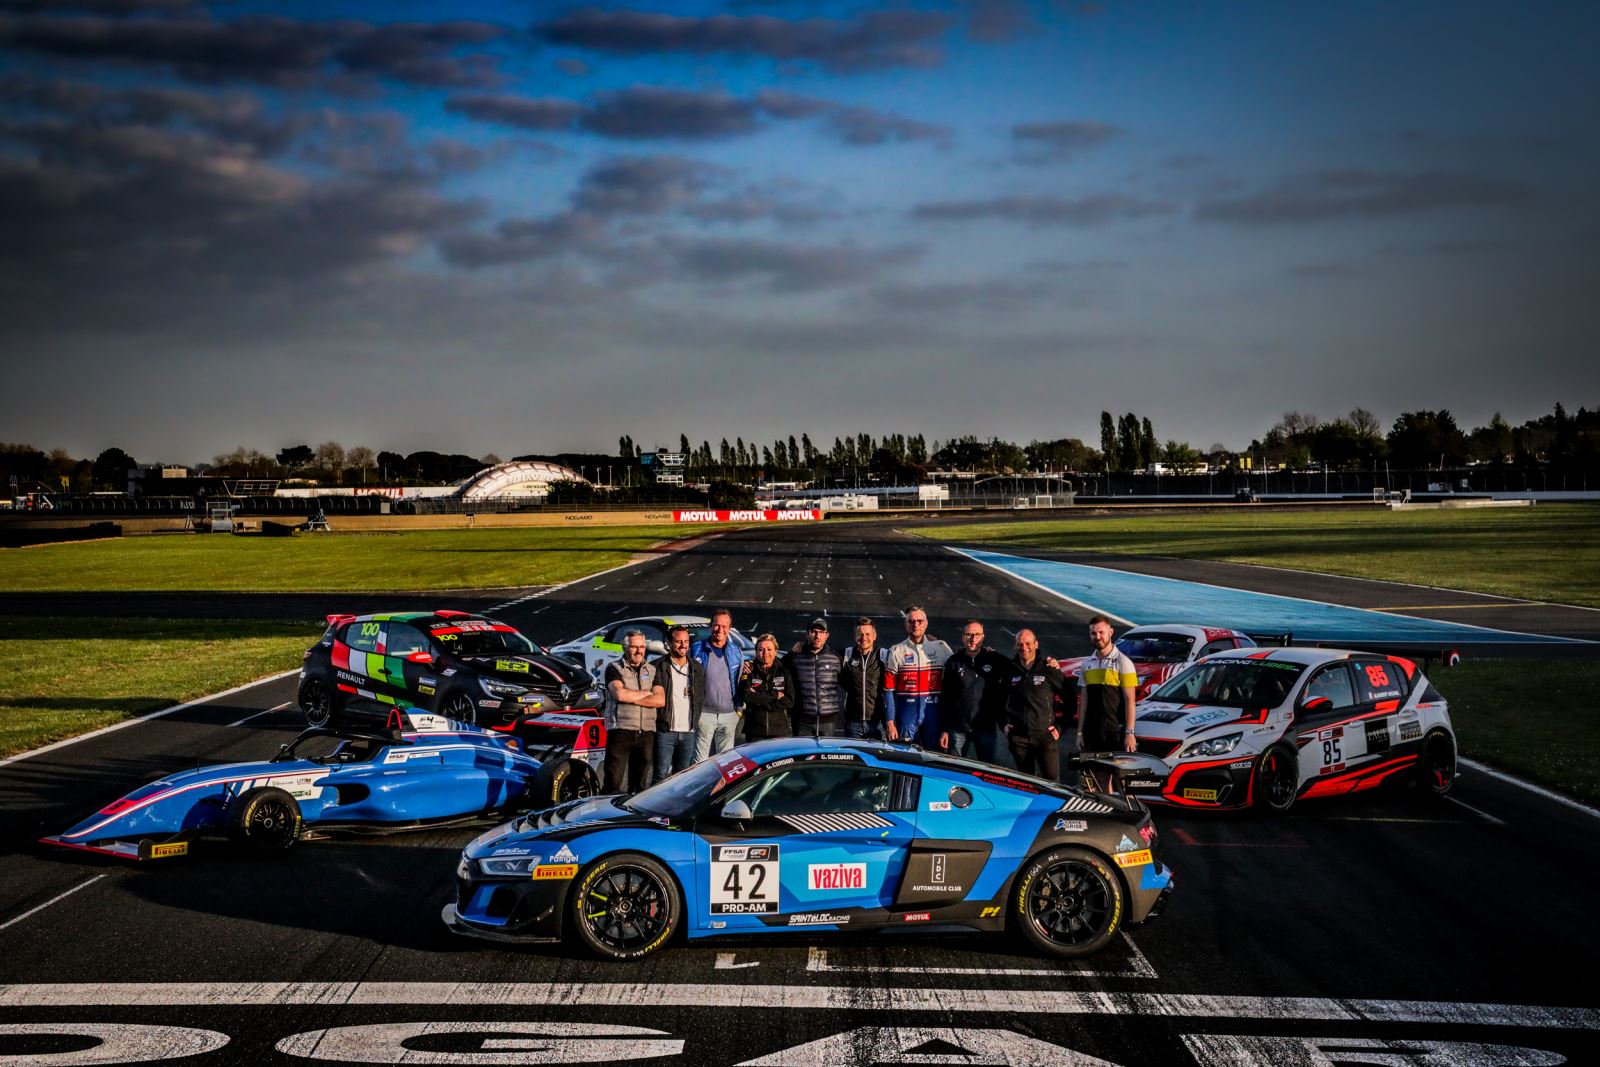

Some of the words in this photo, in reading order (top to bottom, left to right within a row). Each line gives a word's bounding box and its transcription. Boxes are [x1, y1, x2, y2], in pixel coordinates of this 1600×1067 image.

[680, 511, 718, 521] MOTUL
[729, 511, 767, 521] MOTUL
[777, 510, 814, 520] MOTUL
[361, 623, 380, 637] 100
[436, 634, 458, 642] 100
[336, 669, 366, 686] RENAULT
[1365, 665, 1389, 688] 85
[589, 725, 600, 747] 9
[1323, 738, 1341, 765] 85
[154, 845, 185, 856] PIRELLI
[1119, 853, 1149, 864] PIRELLI
[536, 867, 574, 877] PIRELLI
[813, 863, 862, 889] vaziva
[723, 863, 767, 900] 42
[1018, 873, 1032, 914] PIRELLI
[722, 903, 766, 912] PRO-AM
[905, 913, 930, 921] MOTUL
